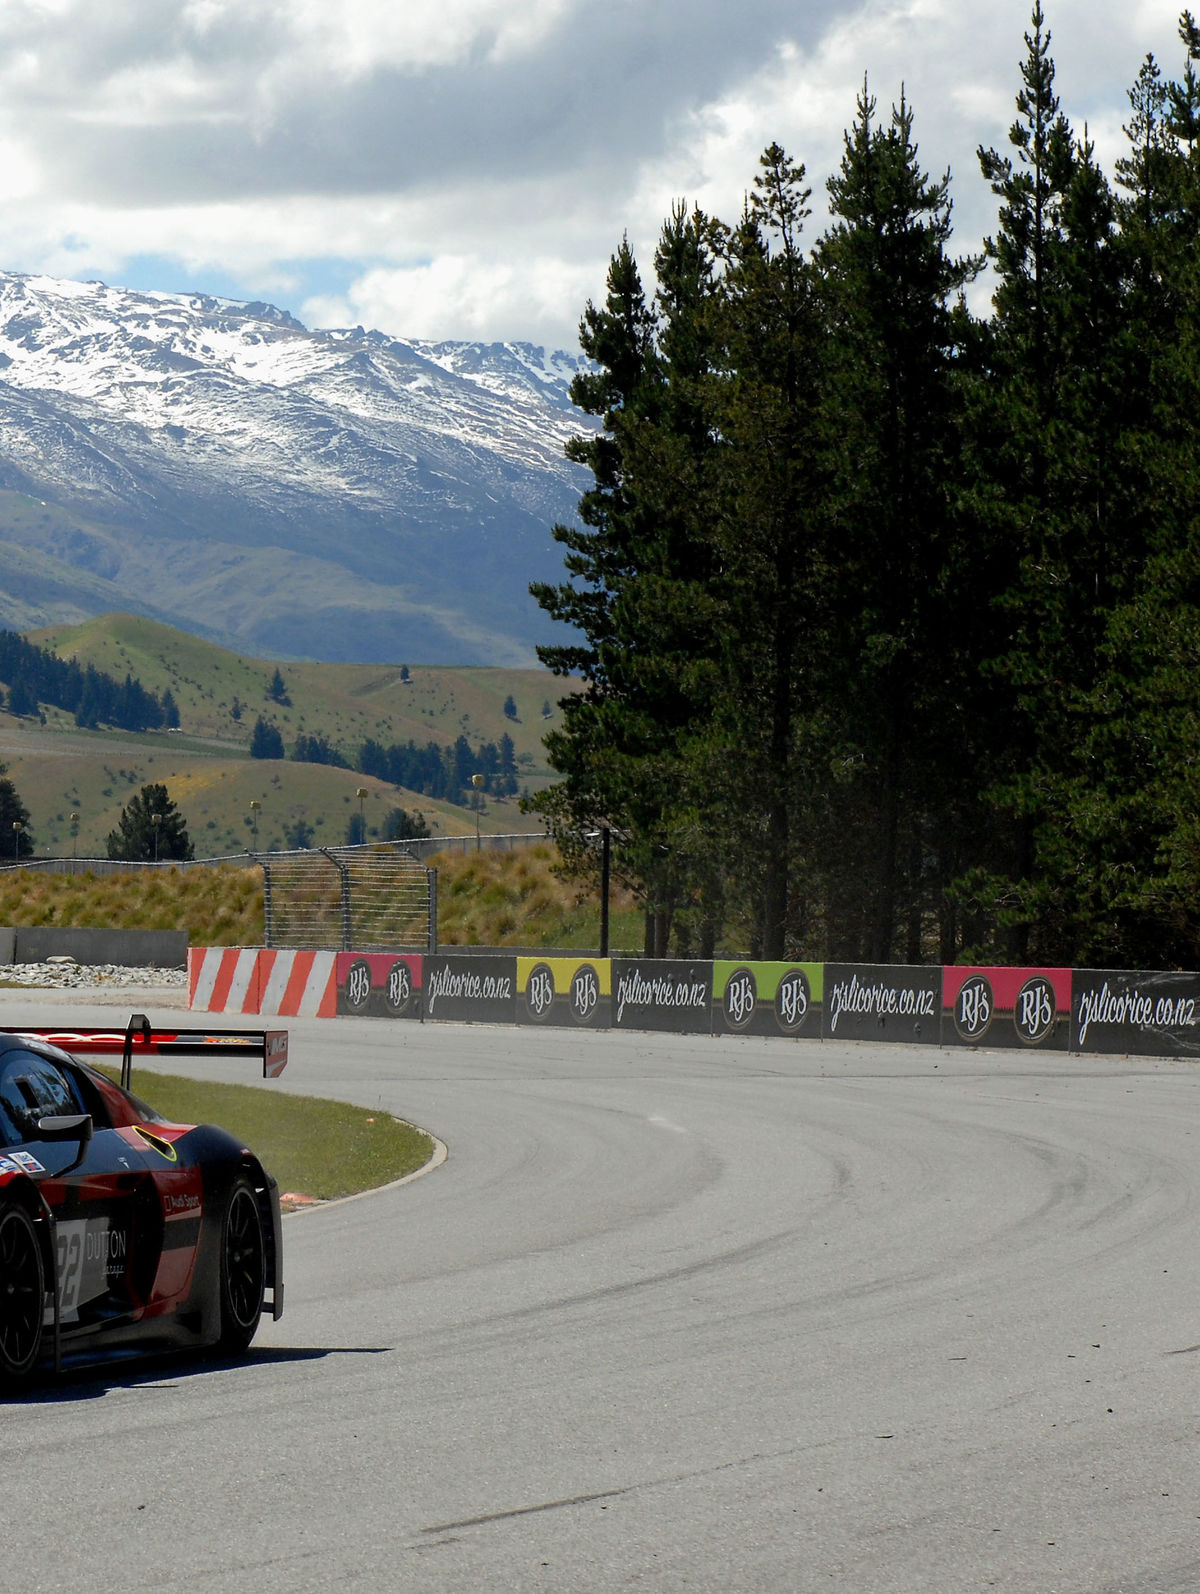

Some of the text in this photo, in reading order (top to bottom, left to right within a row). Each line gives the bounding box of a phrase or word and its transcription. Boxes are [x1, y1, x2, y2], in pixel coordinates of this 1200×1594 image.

[349, 966, 369, 1005] RJ's
[389, 968, 410, 1007] RJ's
[427, 963, 512, 1014] rjslicorice.co.nz
[530, 972, 553, 1014] RJ's
[574, 973, 597, 1016] RJ's
[616, 968, 707, 1023] rjslicorice.co.nz
[728, 976, 754, 1022] RJ's
[780, 978, 807, 1024] RJ's
[830, 974, 935, 1032] rjslicorice.co.nz
[960, 983, 990, 1032] RJ's
[1020, 985, 1052, 1035] RJ's
[1078, 981, 1196, 1046] rjslicorice.co.nz
[87, 1230, 127, 1260] DUTTON
